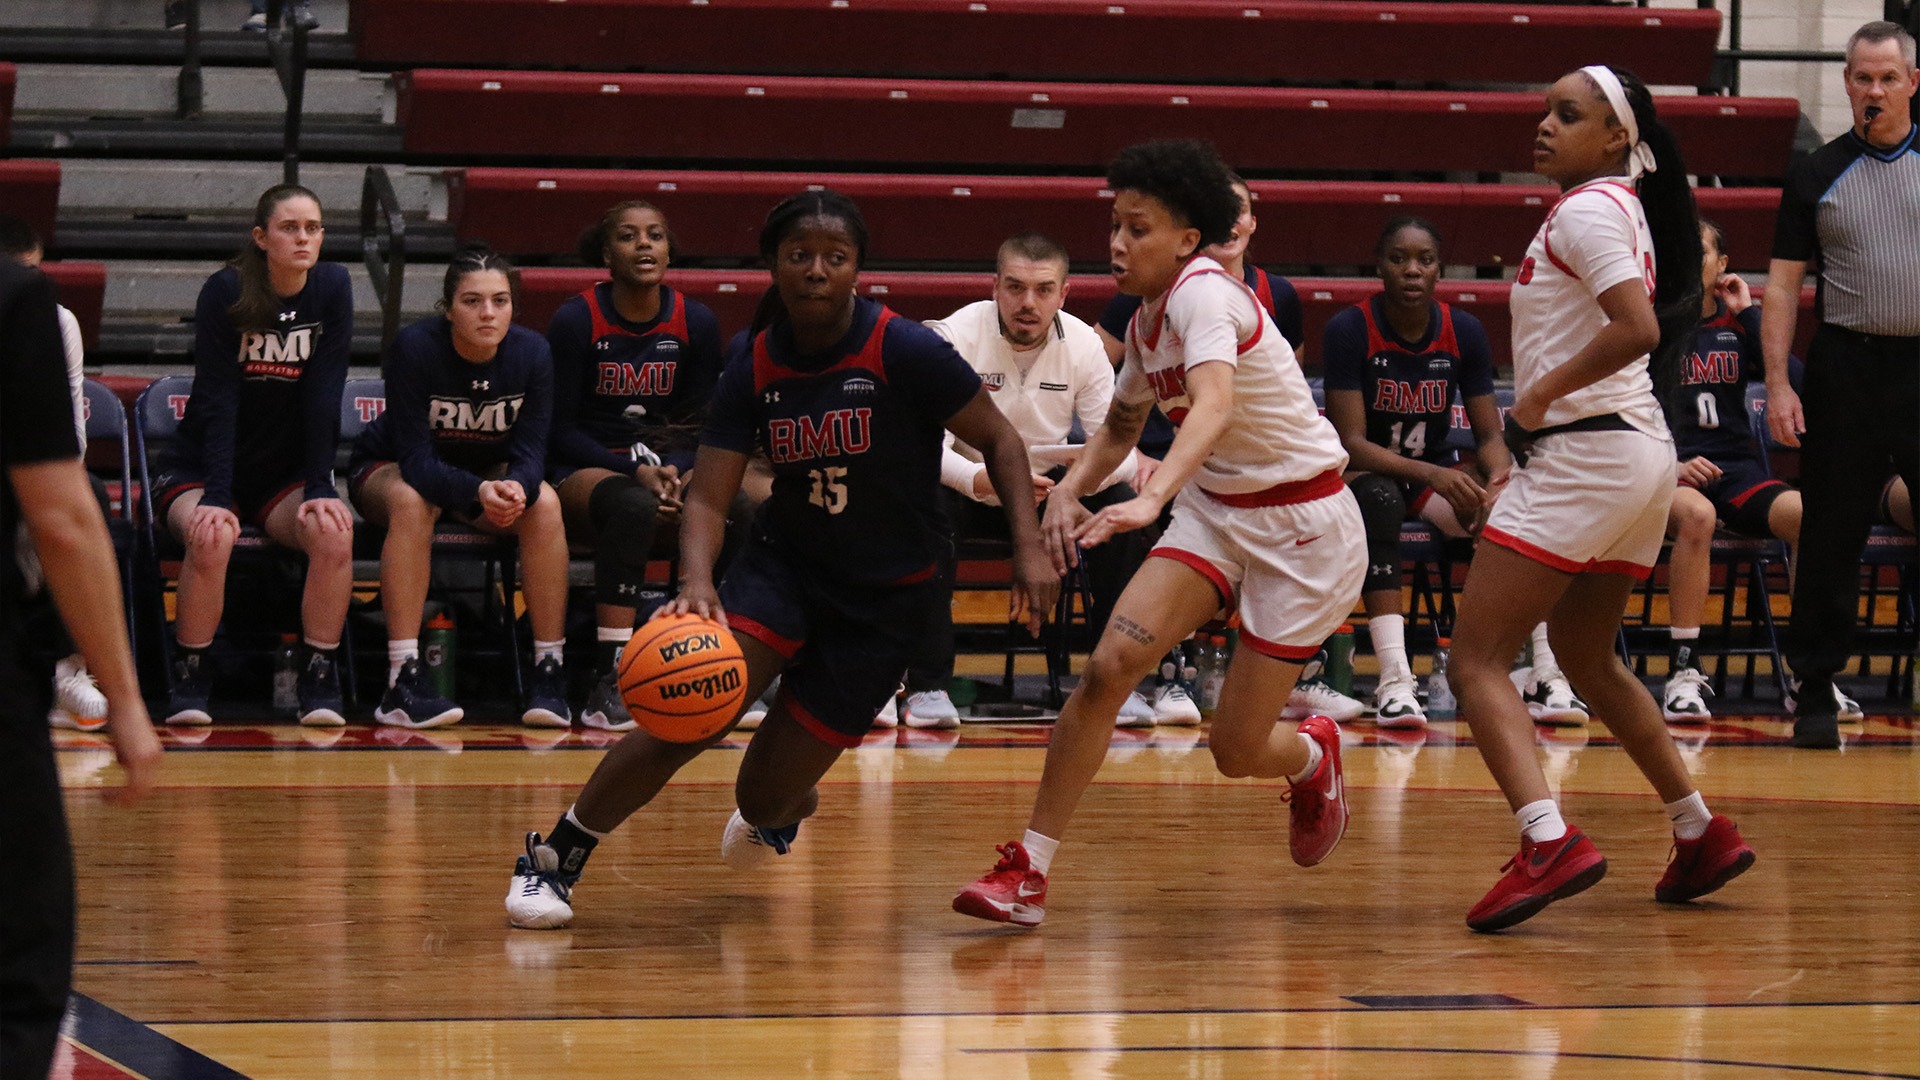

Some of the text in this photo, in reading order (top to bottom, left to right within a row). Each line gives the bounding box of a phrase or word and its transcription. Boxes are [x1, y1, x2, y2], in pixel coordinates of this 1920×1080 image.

[596, 361, 676, 396] RMU
[843, 383, 876, 391] HORIZON
[1373, 378, 1448, 414] RMU
[428, 398, 525, 432] RMU
[1697, 391, 1720, 429] 0
[769, 407, 872, 463] RMU
[1388, 421, 1428, 457] 14
[660, 634, 721, 663] NCAA
[659, 667, 741, 699] Wilson
